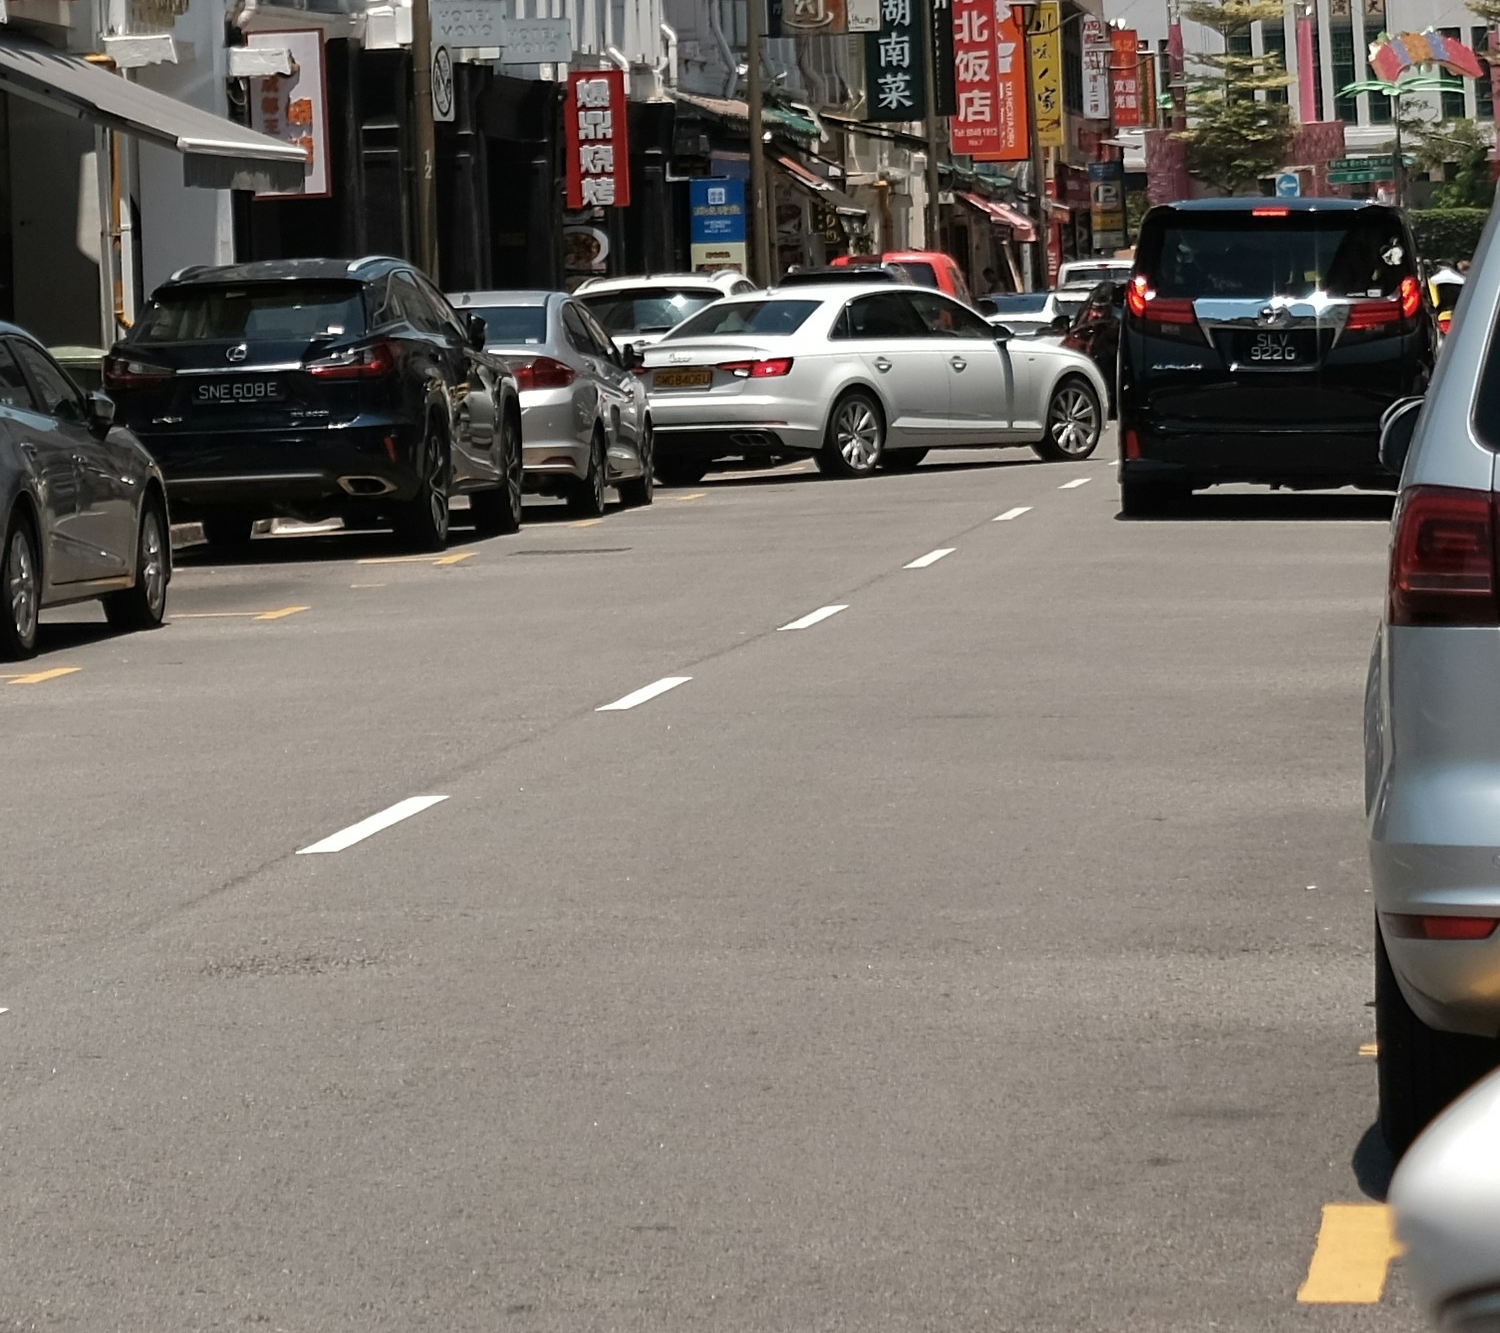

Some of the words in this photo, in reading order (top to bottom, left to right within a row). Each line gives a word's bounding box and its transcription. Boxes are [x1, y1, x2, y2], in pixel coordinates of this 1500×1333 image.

[440, 9, 496, 22] HOTEL
[440, 24, 492, 37] MONO
[1256, 333, 1289, 348] SLV
[1250, 346, 1295, 361] 922G
[198, 383, 231, 400] SNE
[232, 381, 279, 398] 608E
